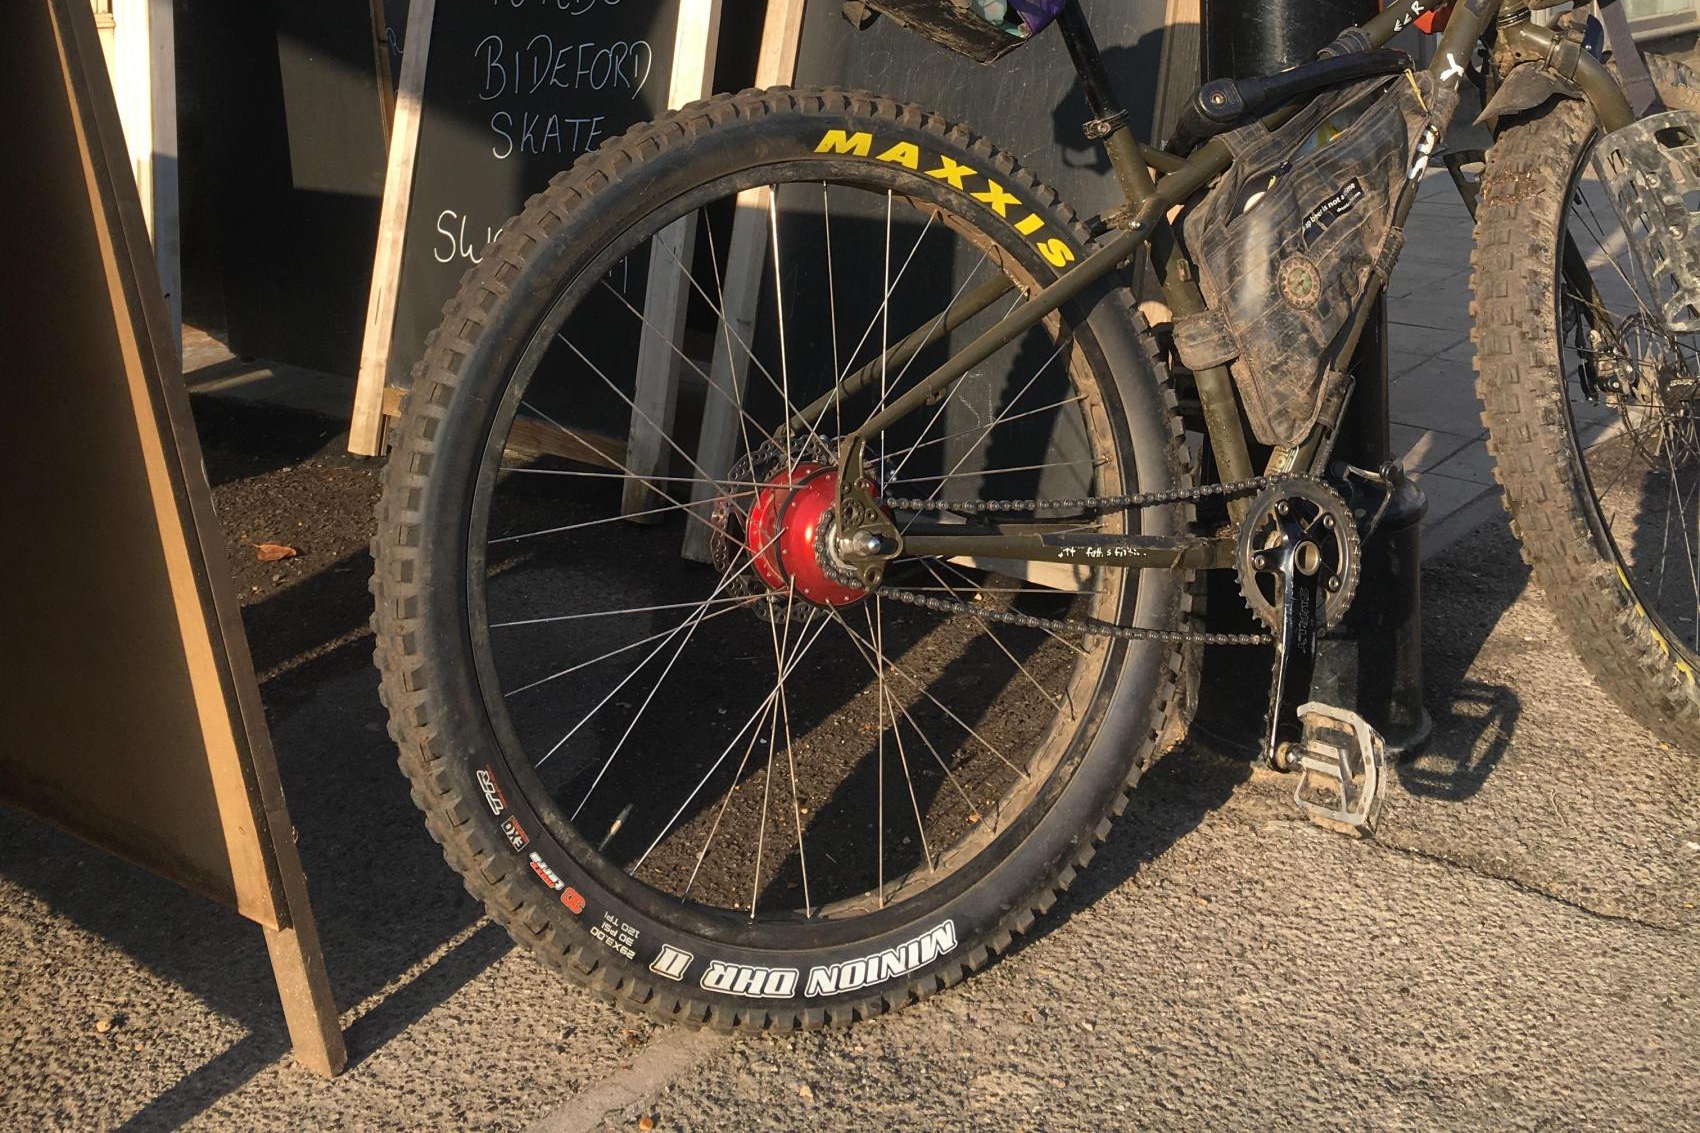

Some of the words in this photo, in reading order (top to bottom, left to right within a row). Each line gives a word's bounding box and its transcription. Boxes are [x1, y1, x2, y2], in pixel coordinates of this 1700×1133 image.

[474, 34, 652, 101] BIDEFORD
[490, 111, 605, 159] SKATE
[813, 129, 1076, 268] MAXXIS
[1327, 196, 1341, 208] not
[601, 922, 618, 937] PSI
[603, 911, 619, 927] TPI
[621, 922, 641, 939] 120
[590, 926, 636, 960] 29X3.00
[804, 919, 958, 998] MINION
[700, 961, 799, 998] DHR
